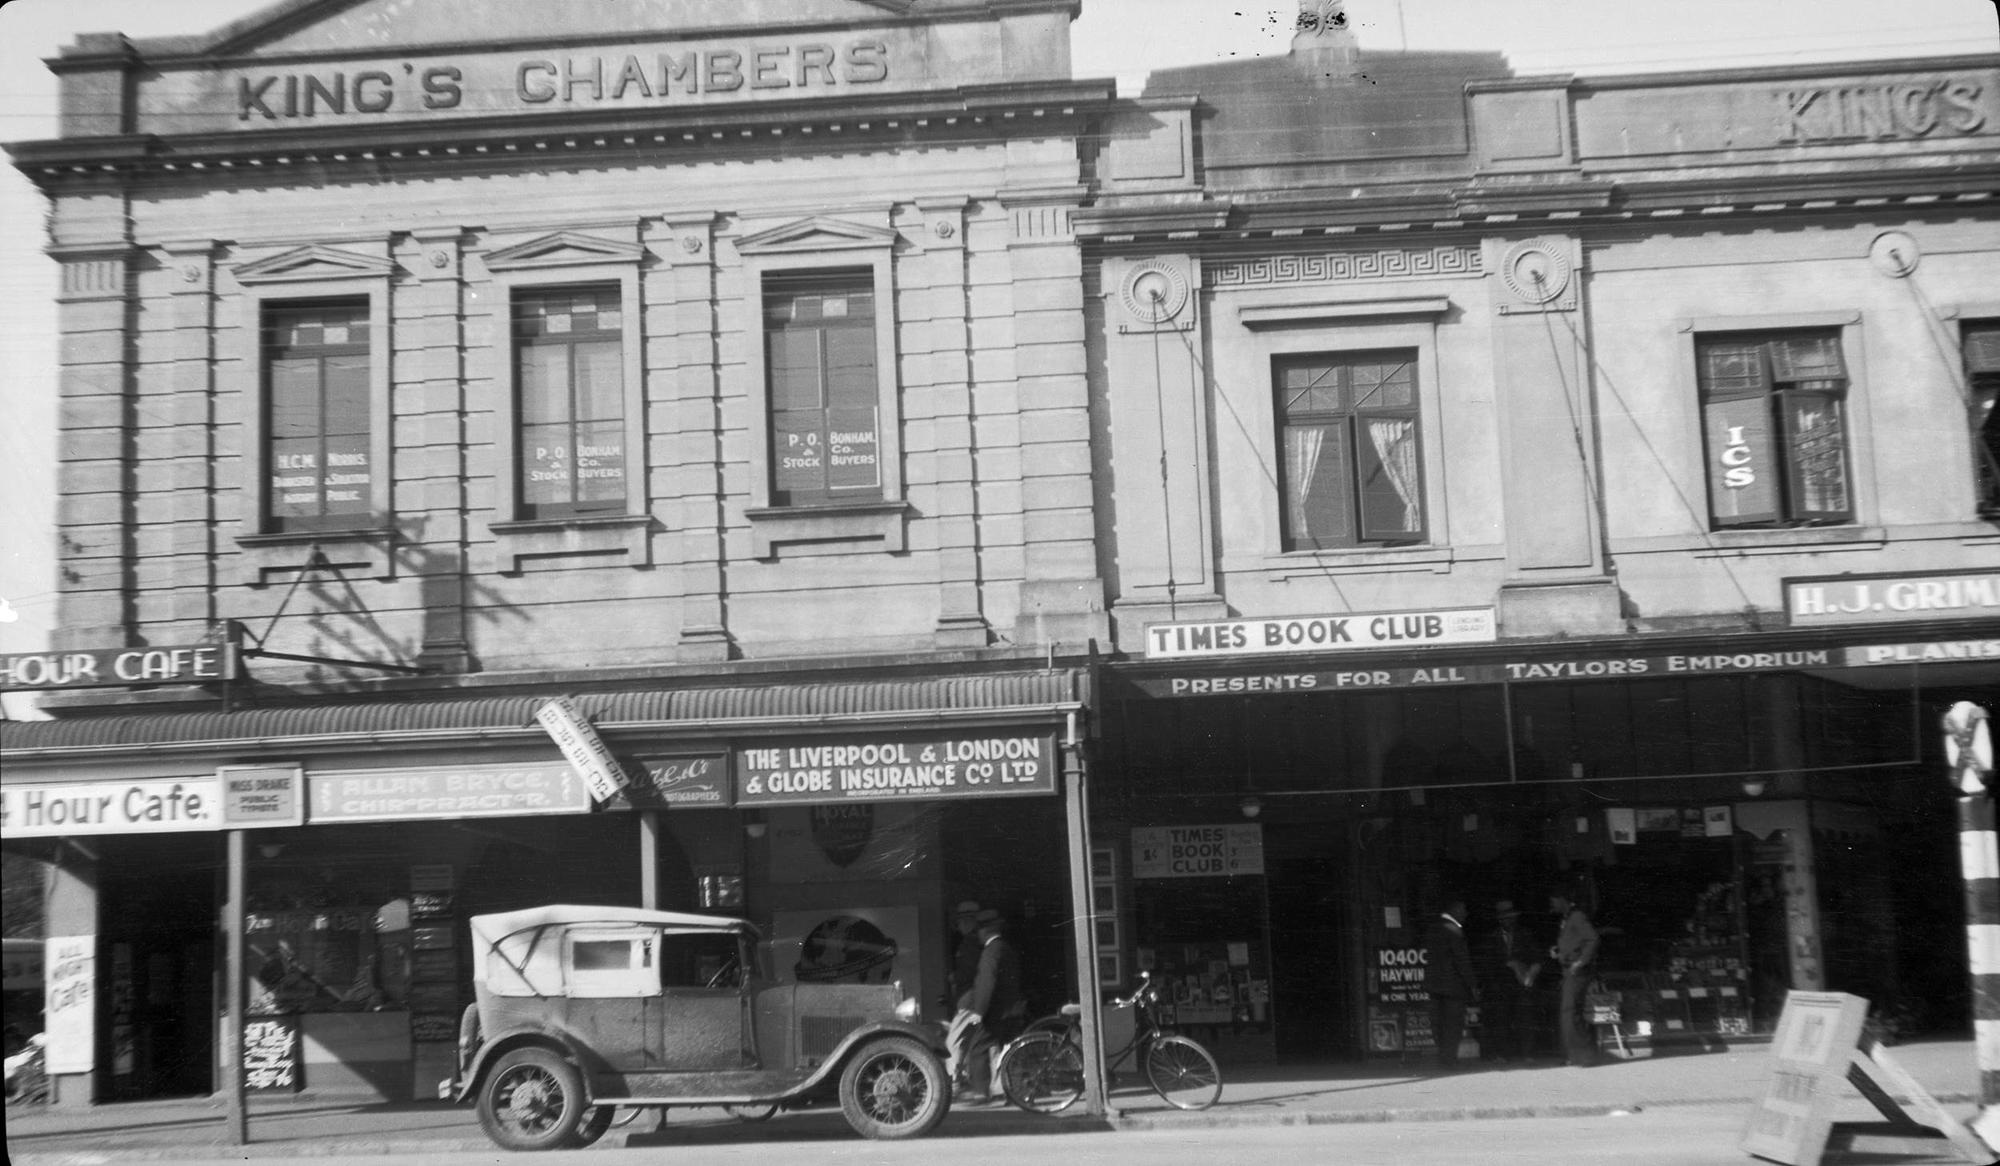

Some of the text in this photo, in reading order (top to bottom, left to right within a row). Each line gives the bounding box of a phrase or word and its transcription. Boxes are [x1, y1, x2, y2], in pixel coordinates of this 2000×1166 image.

[238, 41, 889, 120] KING'S CHAMBERS
[1774, 80, 1986, 144] KING'S
[783, 455, 875, 468] STOCK BUYERS
[530, 471, 571, 482] STOCK
[1152, 615, 1443, 652] TIMES BOOK CLUB
[0, 647, 219, 686] HOUR CAFE
[1505, 650, 1828, 679] TAYLOR'S EMPORIUM
[1171, 668, 1466, 695] PRESENTS FOR ALL
[744, 737, 1039, 770] THE LIVERPOOL & LONDON
[342, 776, 431, 797] ALLAN
[746, 774, 762, 794] &
[767, 770, 832, 793] GLOBE
[840, 764, 955, 789] INSURANCE
[25, 790, 112, 827] Hour
[124, 784, 209, 824] Cafe.
[240, 795, 279, 803] PUBLIC
[1170, 828, 1225, 843] TIMES
[1172, 843, 1225, 858] BOOK
[1172, 858, 1224, 873] CLUB
